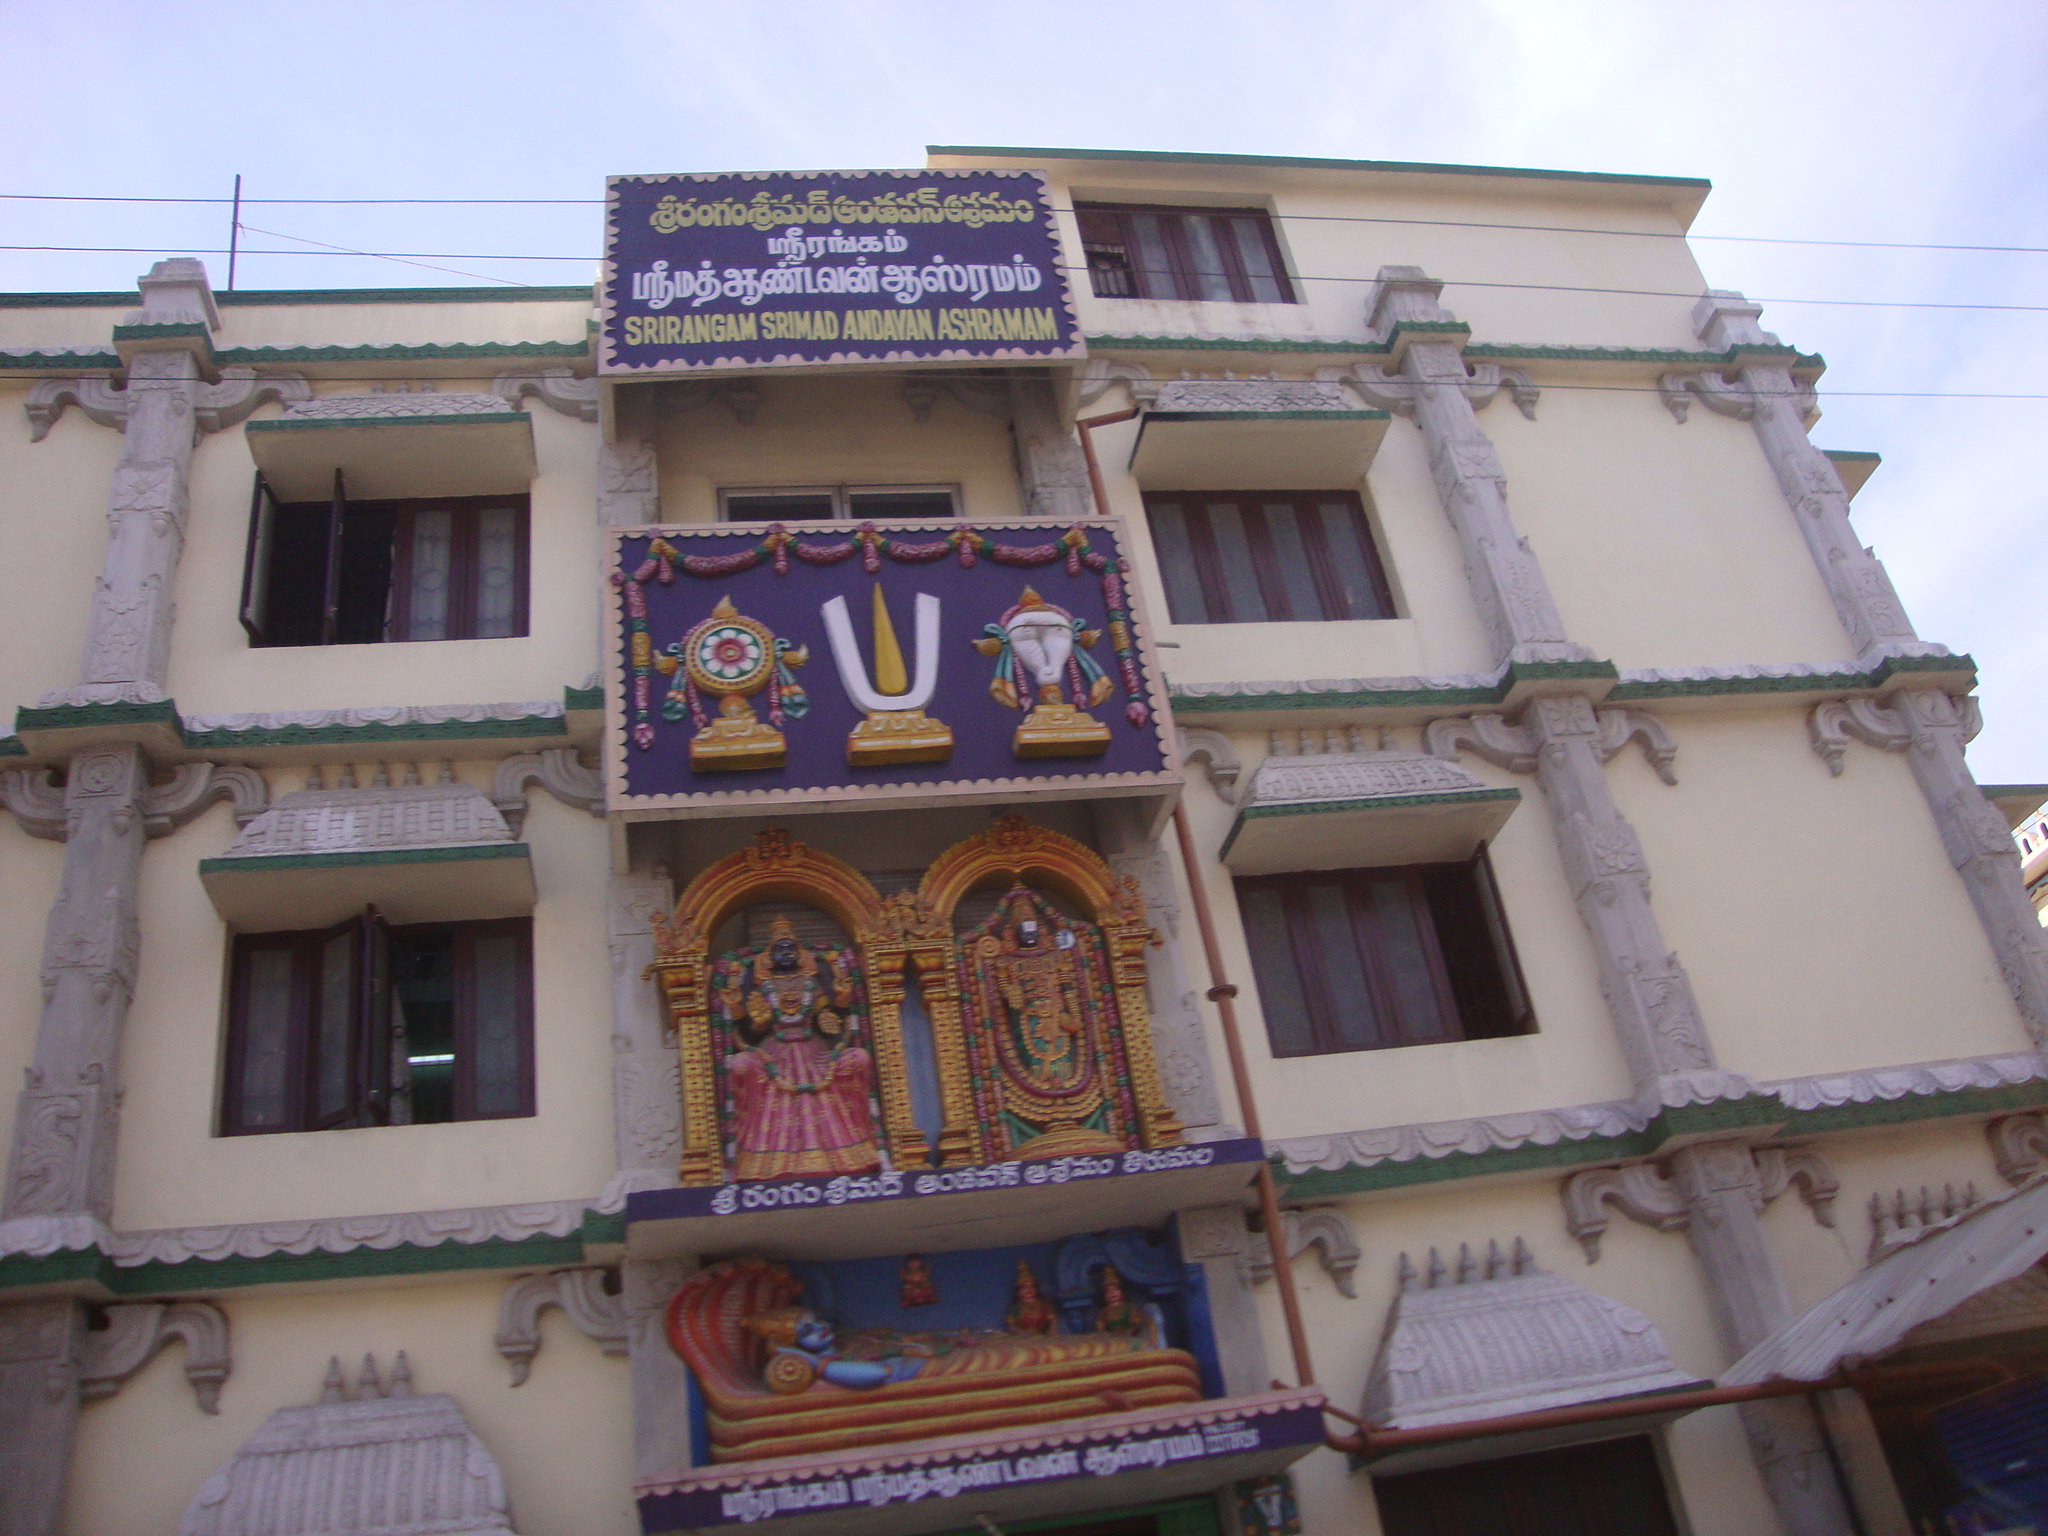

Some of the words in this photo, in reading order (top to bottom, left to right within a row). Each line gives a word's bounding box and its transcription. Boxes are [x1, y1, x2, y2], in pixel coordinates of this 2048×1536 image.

[624, 313, 758, 345] SRIRANGAM
[760, 310, 840, 340] SRIMAD
[842, 308, 935, 341] ANDAVAN
[937, 307, 1059, 340] ASHRAMAM
